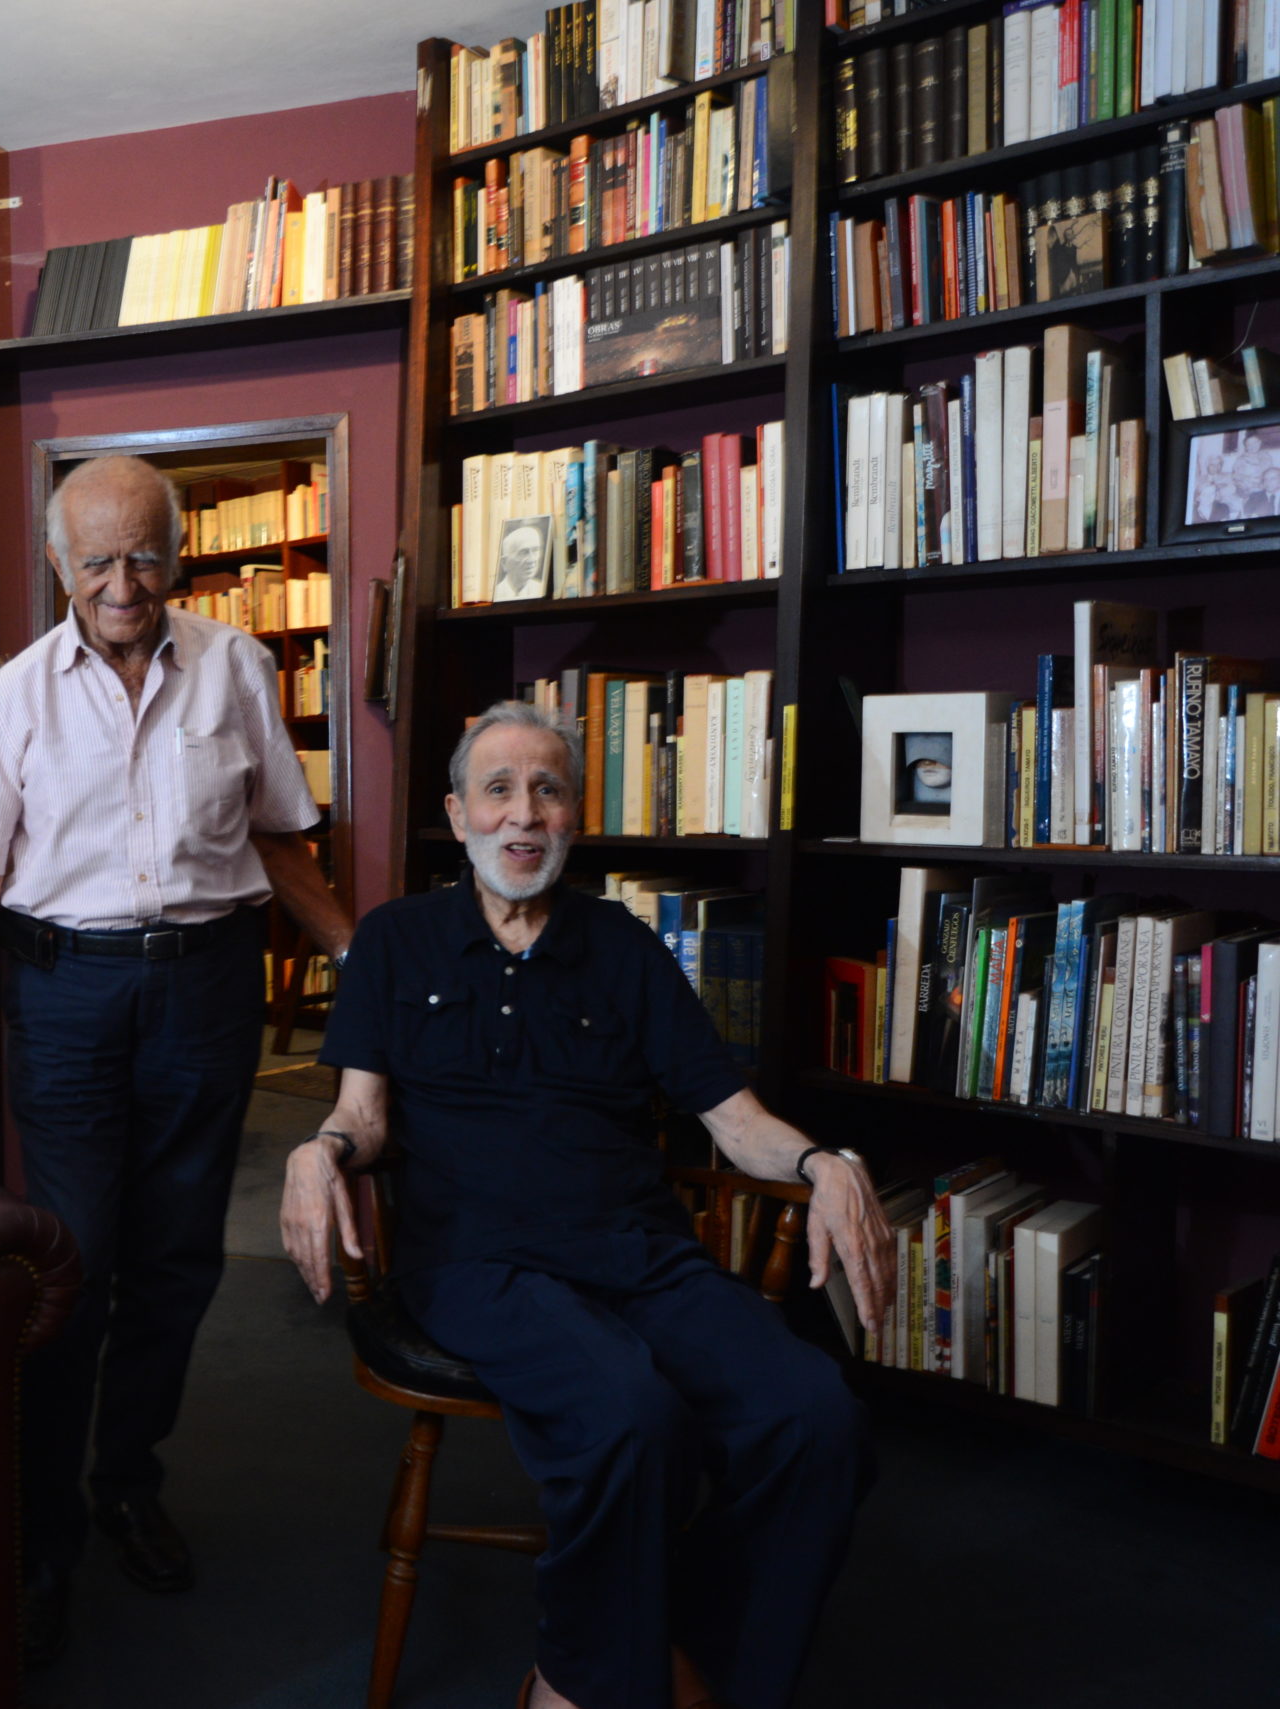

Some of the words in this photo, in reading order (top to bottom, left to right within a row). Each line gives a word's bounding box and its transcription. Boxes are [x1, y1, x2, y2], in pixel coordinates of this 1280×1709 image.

[705, 249, 715, 260] IX
[587, 321, 621, 335] OBRAS
[851, 458, 861, 507] Rembrandt
[870, 456, 879, 505] Rembrandt
[888, 480, 897, 535] Rembrandt
[1186, 664, 1203, 716] RUFINO
[1185, 719, 1203, 781] TAMAYO
[683, 937, 700, 956] de
[941, 919, 950, 954] GONZALO
[989, 939, 1005, 985] MATTA
[1112, 929, 1130, 1028] CONTEMPORANEA
[1133, 930, 1150, 1030] CONTEMPORANEA
[1147, 931, 1164, 1032] CONTEMPORANEA
[918, 963, 932, 1013] BARREDA
[1008, 1010, 1016, 1034] MATTA
[1110, 1033, 1124, 1080] PINTURA
[1130, 1034, 1143, 1081] PINTURA
[1145, 1036, 1157, 1083] PINTURA
